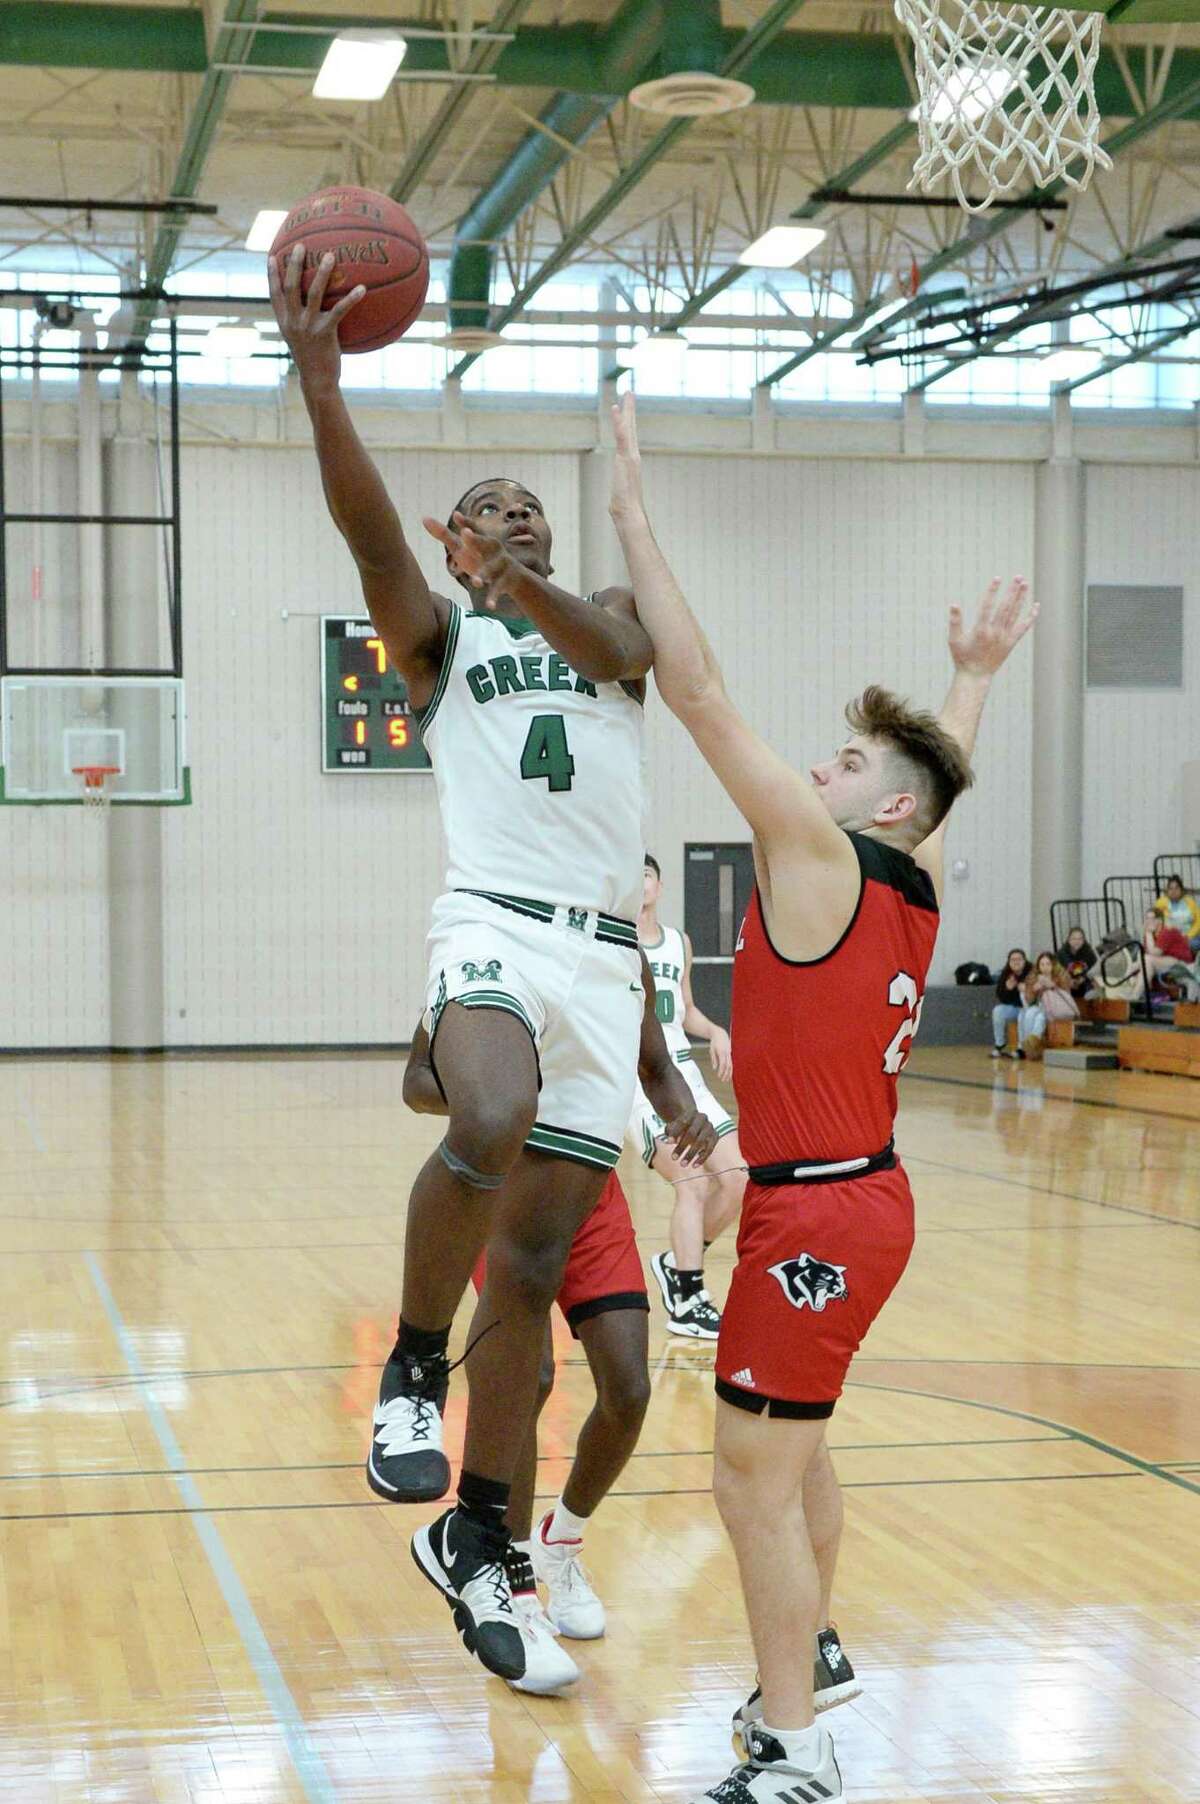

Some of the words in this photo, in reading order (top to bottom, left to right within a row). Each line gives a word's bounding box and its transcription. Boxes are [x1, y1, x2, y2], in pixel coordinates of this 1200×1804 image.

[366, 640, 387, 674] 7
[356, 719, 366, 745] 1
[389, 718, 407, 747] 5
[520, 714, 575, 792] 4
